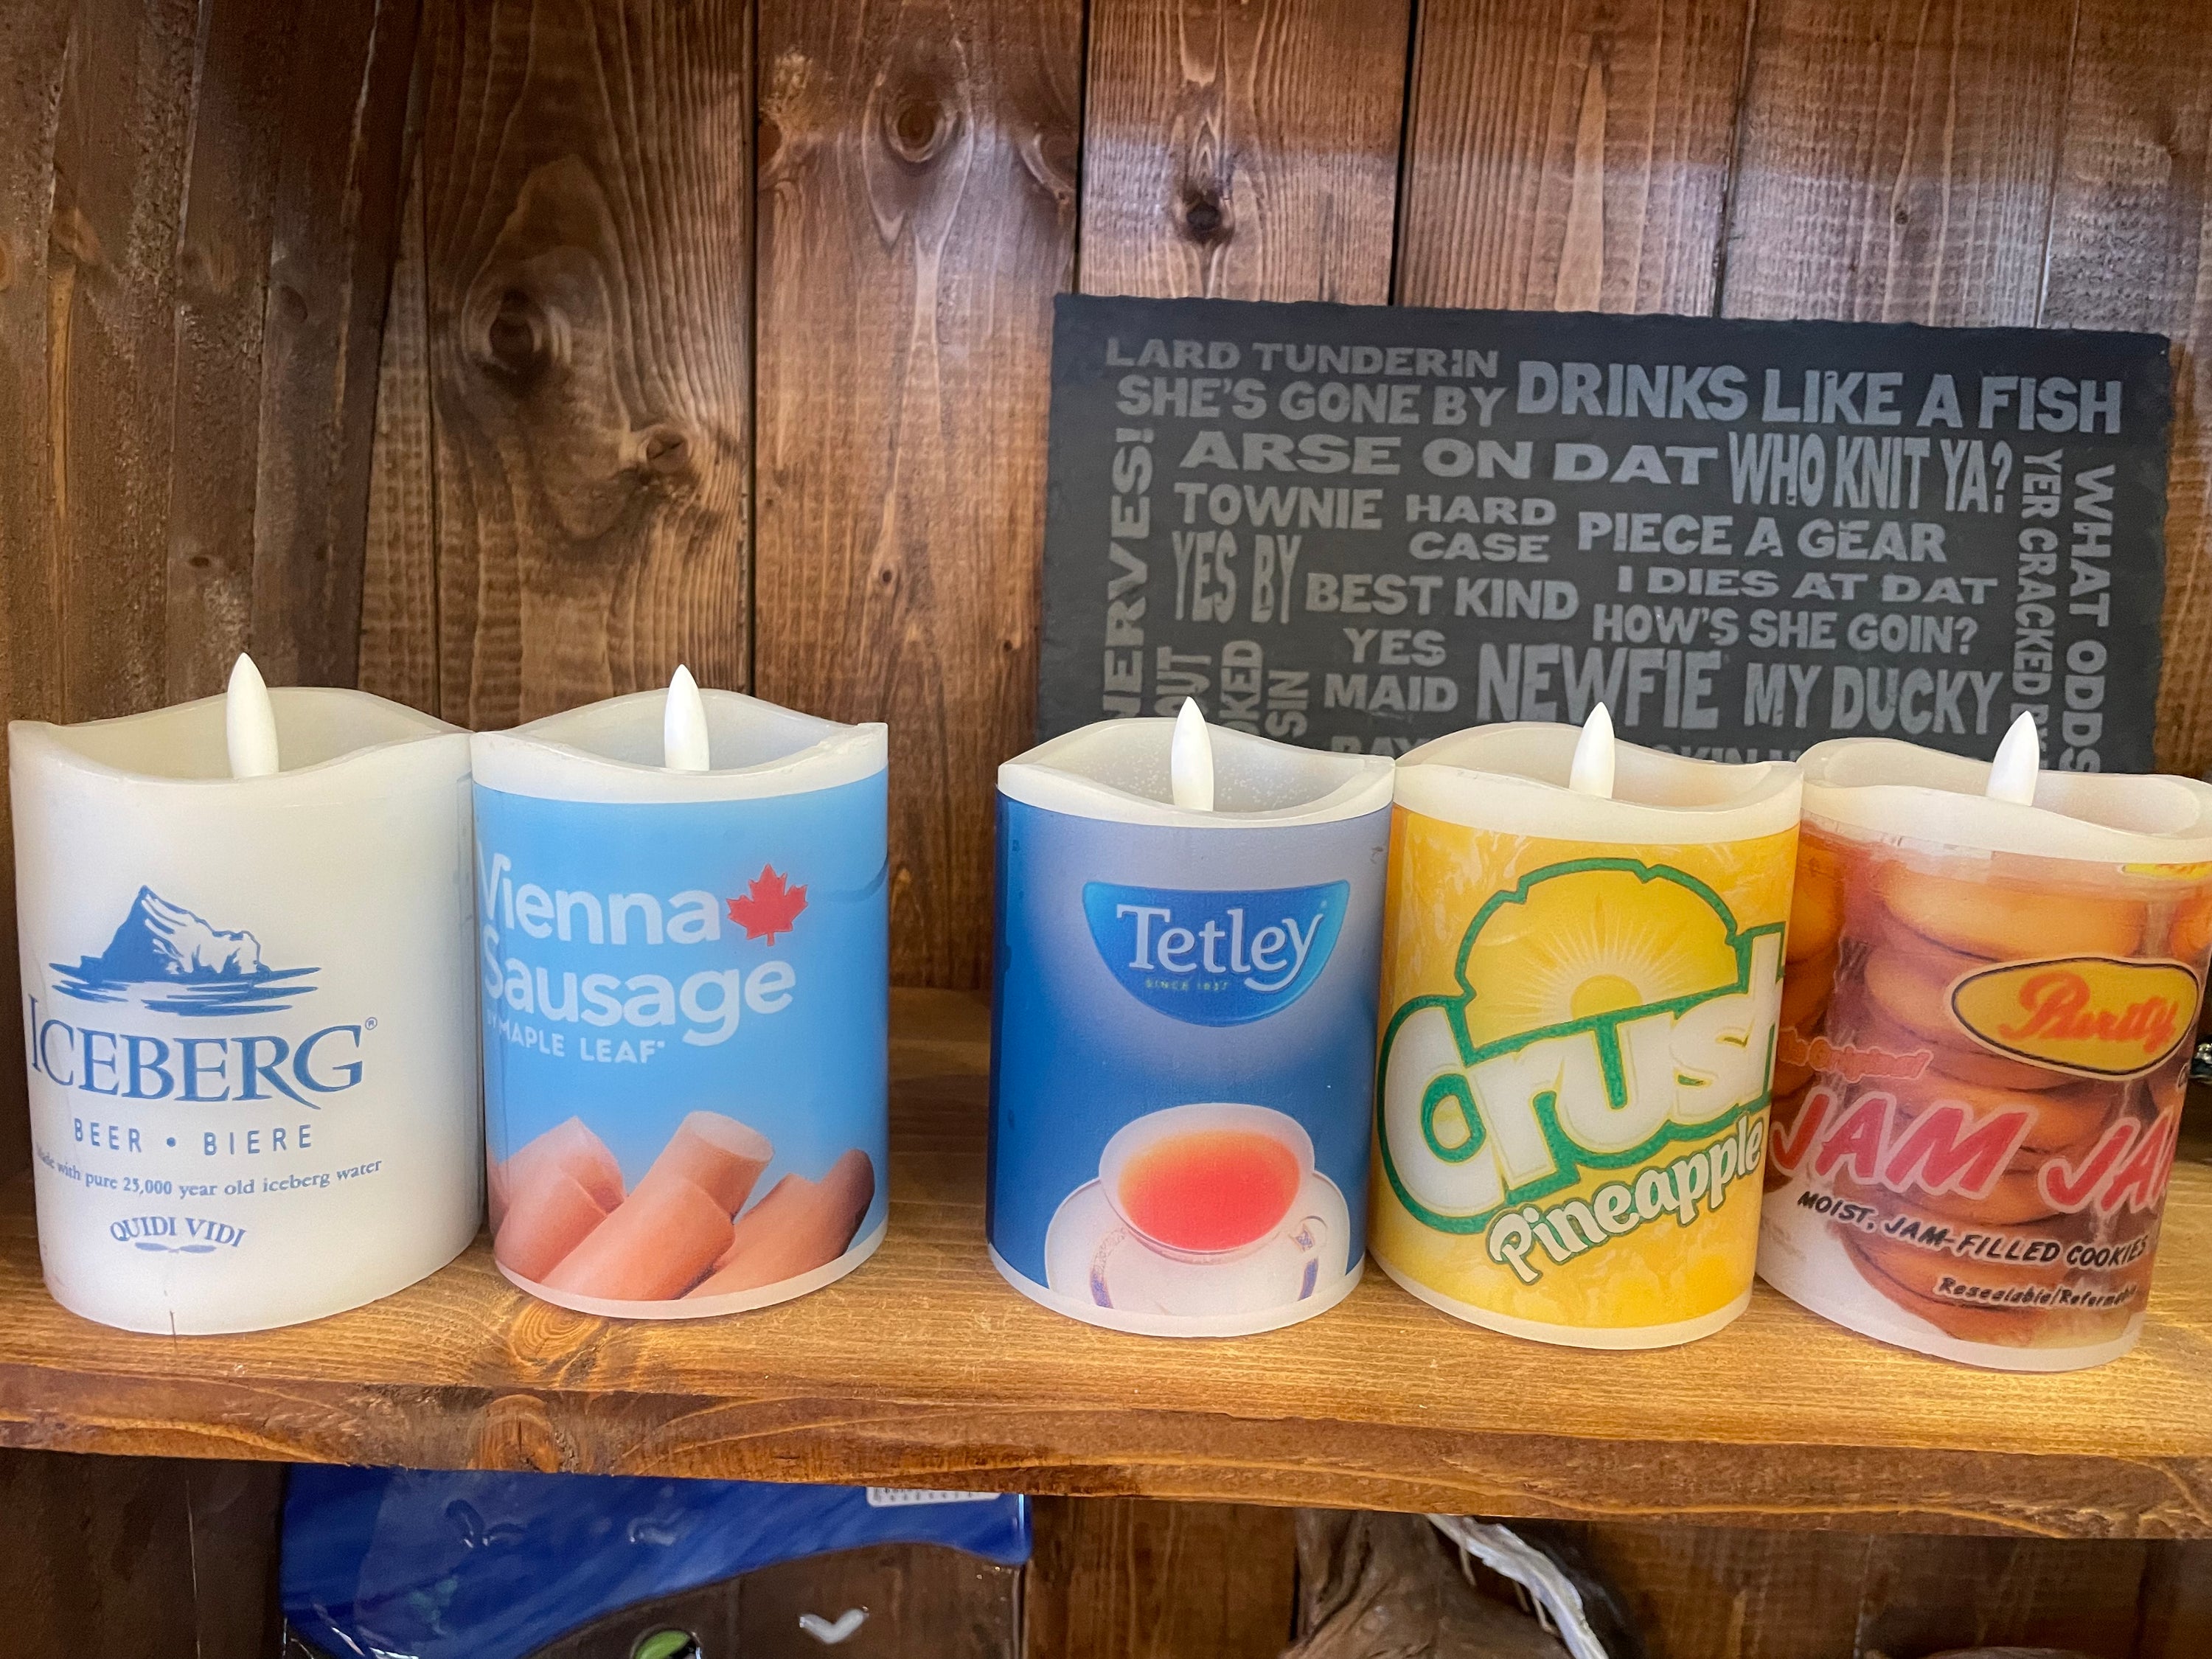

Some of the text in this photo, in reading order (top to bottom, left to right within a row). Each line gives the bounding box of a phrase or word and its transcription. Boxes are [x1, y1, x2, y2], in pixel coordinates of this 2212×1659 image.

[1107, 338, 1498, 378] LARD TUNDERIN
[1116, 374, 1507, 427] SHE'S GONE BY
[1517, 360, 2123, 435] DRINKS LIKE A FISH
[1180, 431, 1719, 487] ARSE ON DAT
[1728, 431, 2013, 513] WHO KNIT YA?
[2020, 448, 2063, 519] YER
[1172, 481, 1384, 530] TOWNIE
[1406, 494, 1557, 526] HARD
[1408, 532, 1550, 563] CASE
[1578, 511, 1947, 563] PIECE A GEAR
[1172, 530, 1302, 625] YES BY
[1305, 572, 1579, 621] BEST KIND
[1617, 566, 1998, 604] I DIES AT DAT
[1593, 603, 1979, 655] HOW'S SHE GOIN?
[2010, 527, 2059, 695] CRACKED
[2059, 464, 2116, 773] WHAT ODDS
[1342, 627, 1447, 665] YES
[1265, 669, 1310, 738] SIN
[1324, 673, 1458, 713] MAID
[1476, 643, 1722, 731] NEWFIE
[1745, 662, 2003, 736] MY DUCKY
[477, 841, 721, 945] Vienna
[1116, 903, 1324, 992] Tetley
[483, 924, 796, 1046] Sausage
[27, 993, 364, 1110] ICEBERG
[499, 1017, 566, 1057] MAPLE
[580, 1037, 656, 1063] LEAF
[74, 1117, 313, 1155] BEER BIERE
[1771, 1091, 2032, 1194] JAM
[58, 1161, 81, 1181] with
[86, 1172, 119, 1189] pure
[123, 1177, 173, 1197] 25,000
[179, 1184, 218, 1200] year
[224, 1179, 254, 1194] old
[263, 1173, 330, 1192] iceberg
[336, 1160, 382, 1180] water
[1488, 1115, 1764, 1284] Pineapple
[110, 1216, 247, 1248] QUIDI VIDI
[1797, 1190, 1874, 1231] MOIST,
[1885, 1217, 2060, 1263] JAM-FILLED
